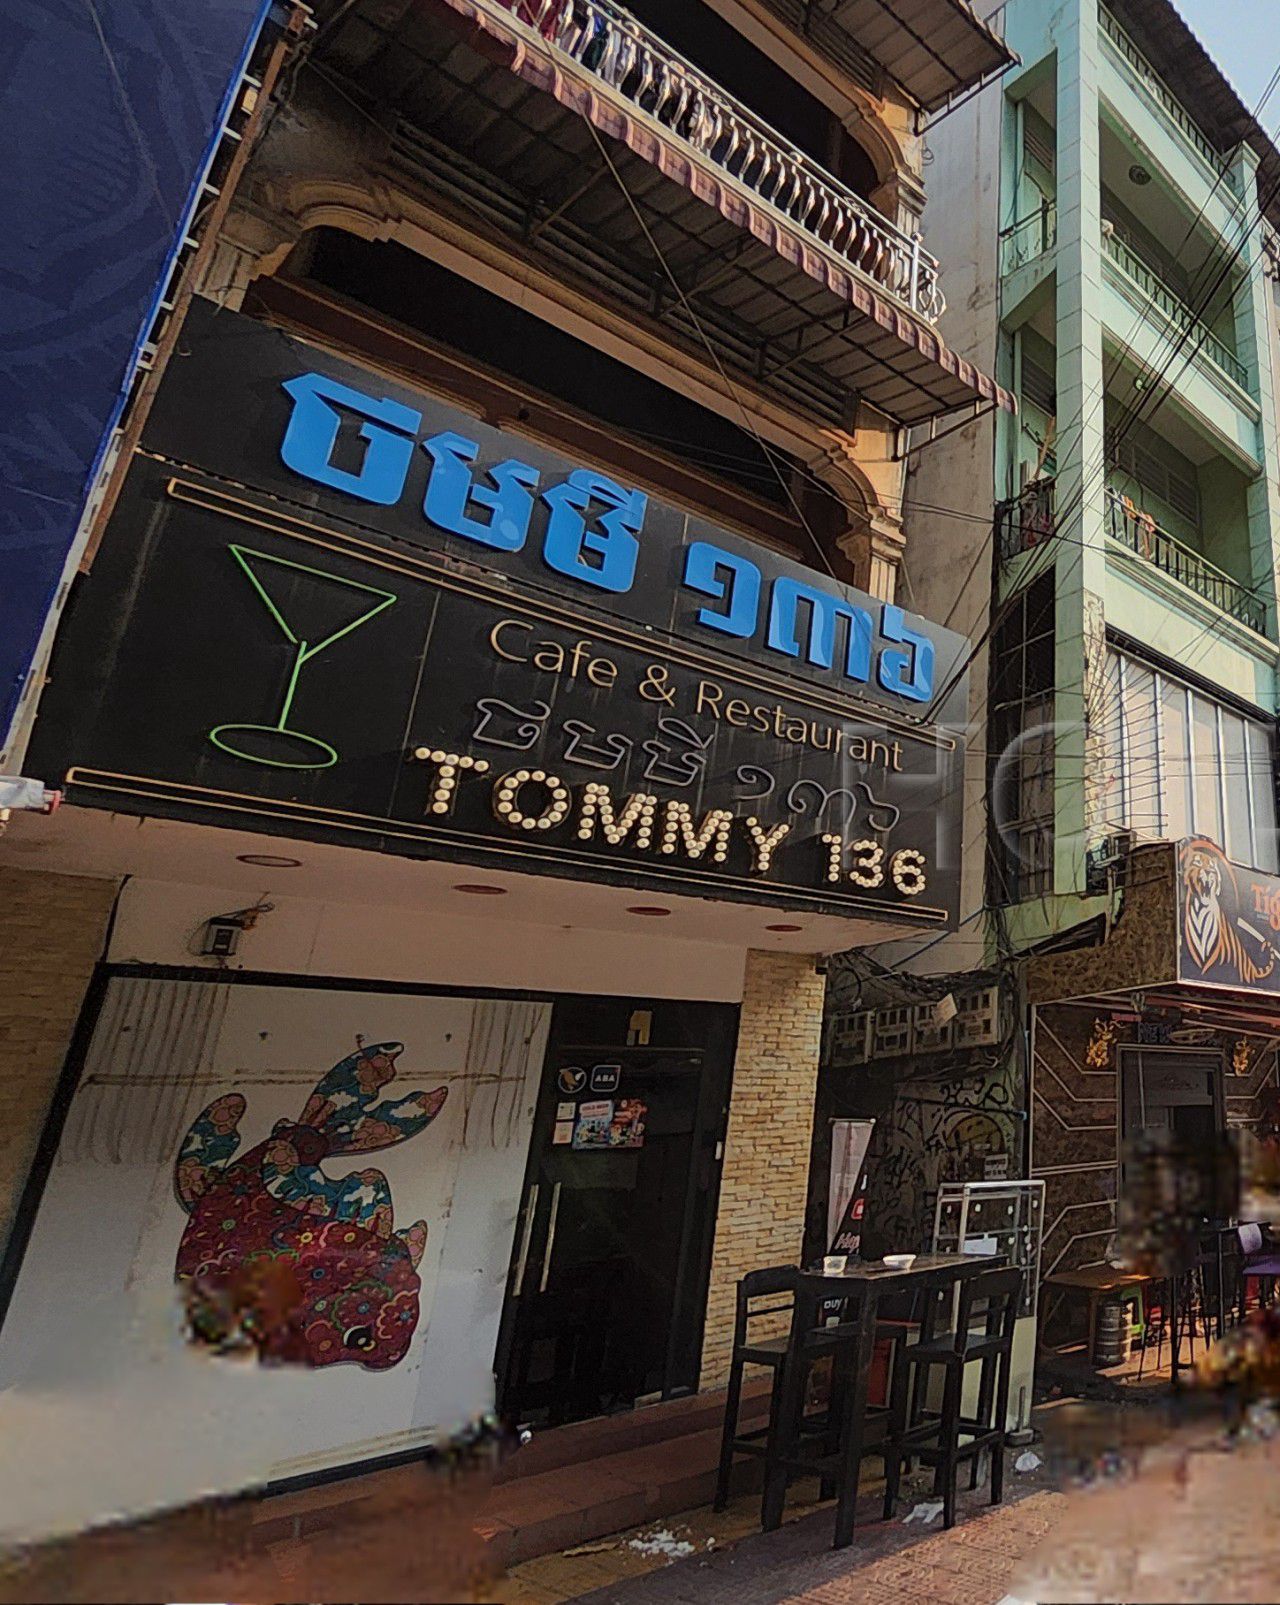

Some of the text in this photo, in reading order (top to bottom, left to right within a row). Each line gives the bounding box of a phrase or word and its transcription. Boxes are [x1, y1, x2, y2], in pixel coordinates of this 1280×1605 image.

[489, 619, 903, 772] Cafe & Restaurant
[683, 540, 936, 704] ១៣៦
[414, 746, 927, 897] TOMMY 136
[736, 763, 900, 833] ១៣៦
[595, 1074, 615, 1082] ABA
